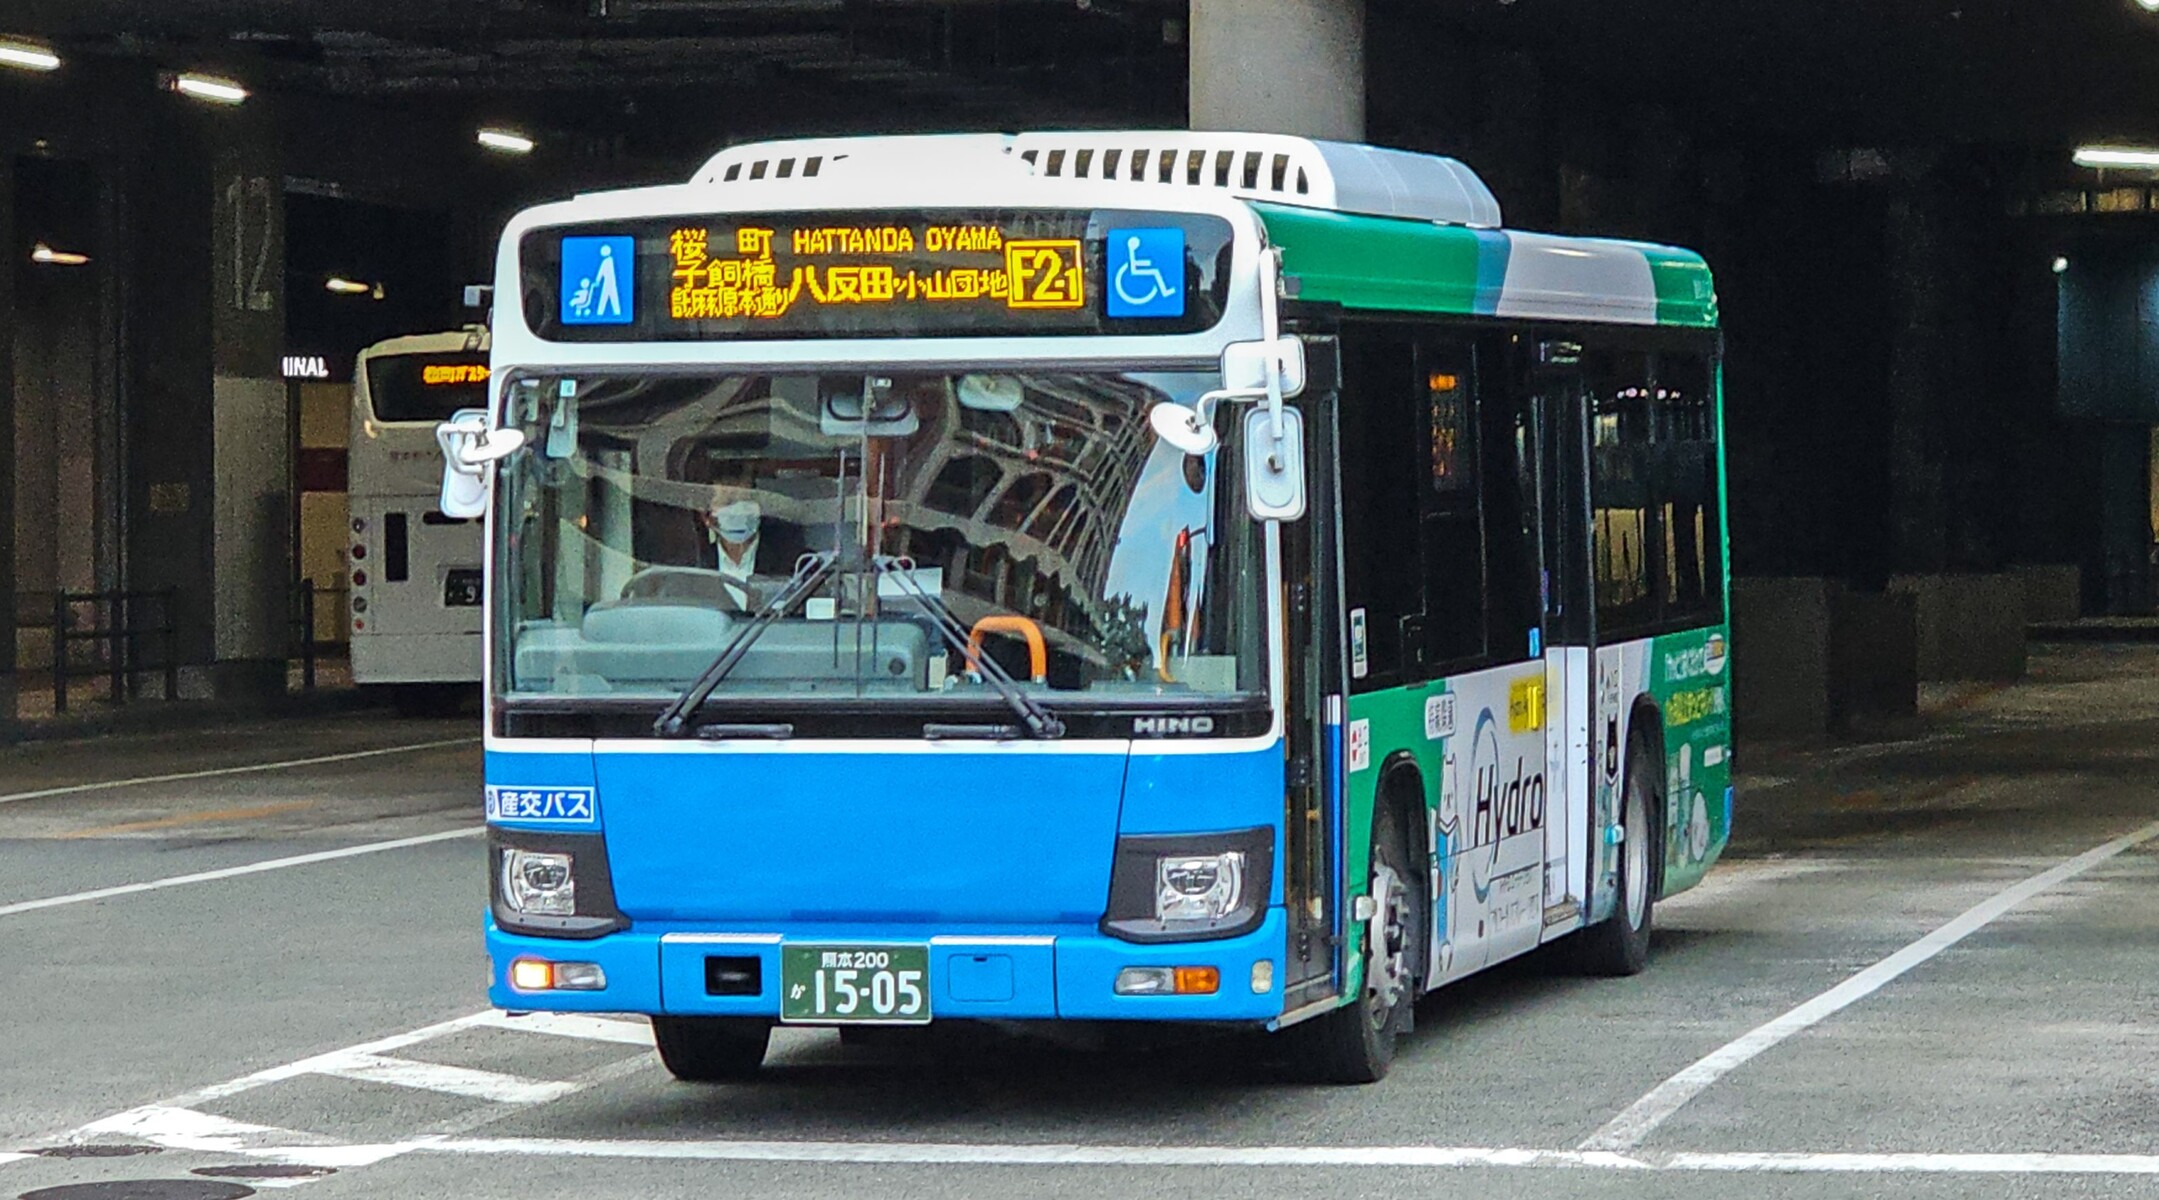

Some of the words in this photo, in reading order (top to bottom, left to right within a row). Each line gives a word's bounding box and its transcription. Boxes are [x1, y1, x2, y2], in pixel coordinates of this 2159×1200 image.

[793, 227, 914, 254] HATTANDA
[925, 227, 1002, 251] OYAMA
[1133, 717, 1214, 733] HINO
[501, 791, 589, 817] 産交バス
[1473, 755, 1544, 865] Hydro
[814, 969, 923, 1015] 15-05
